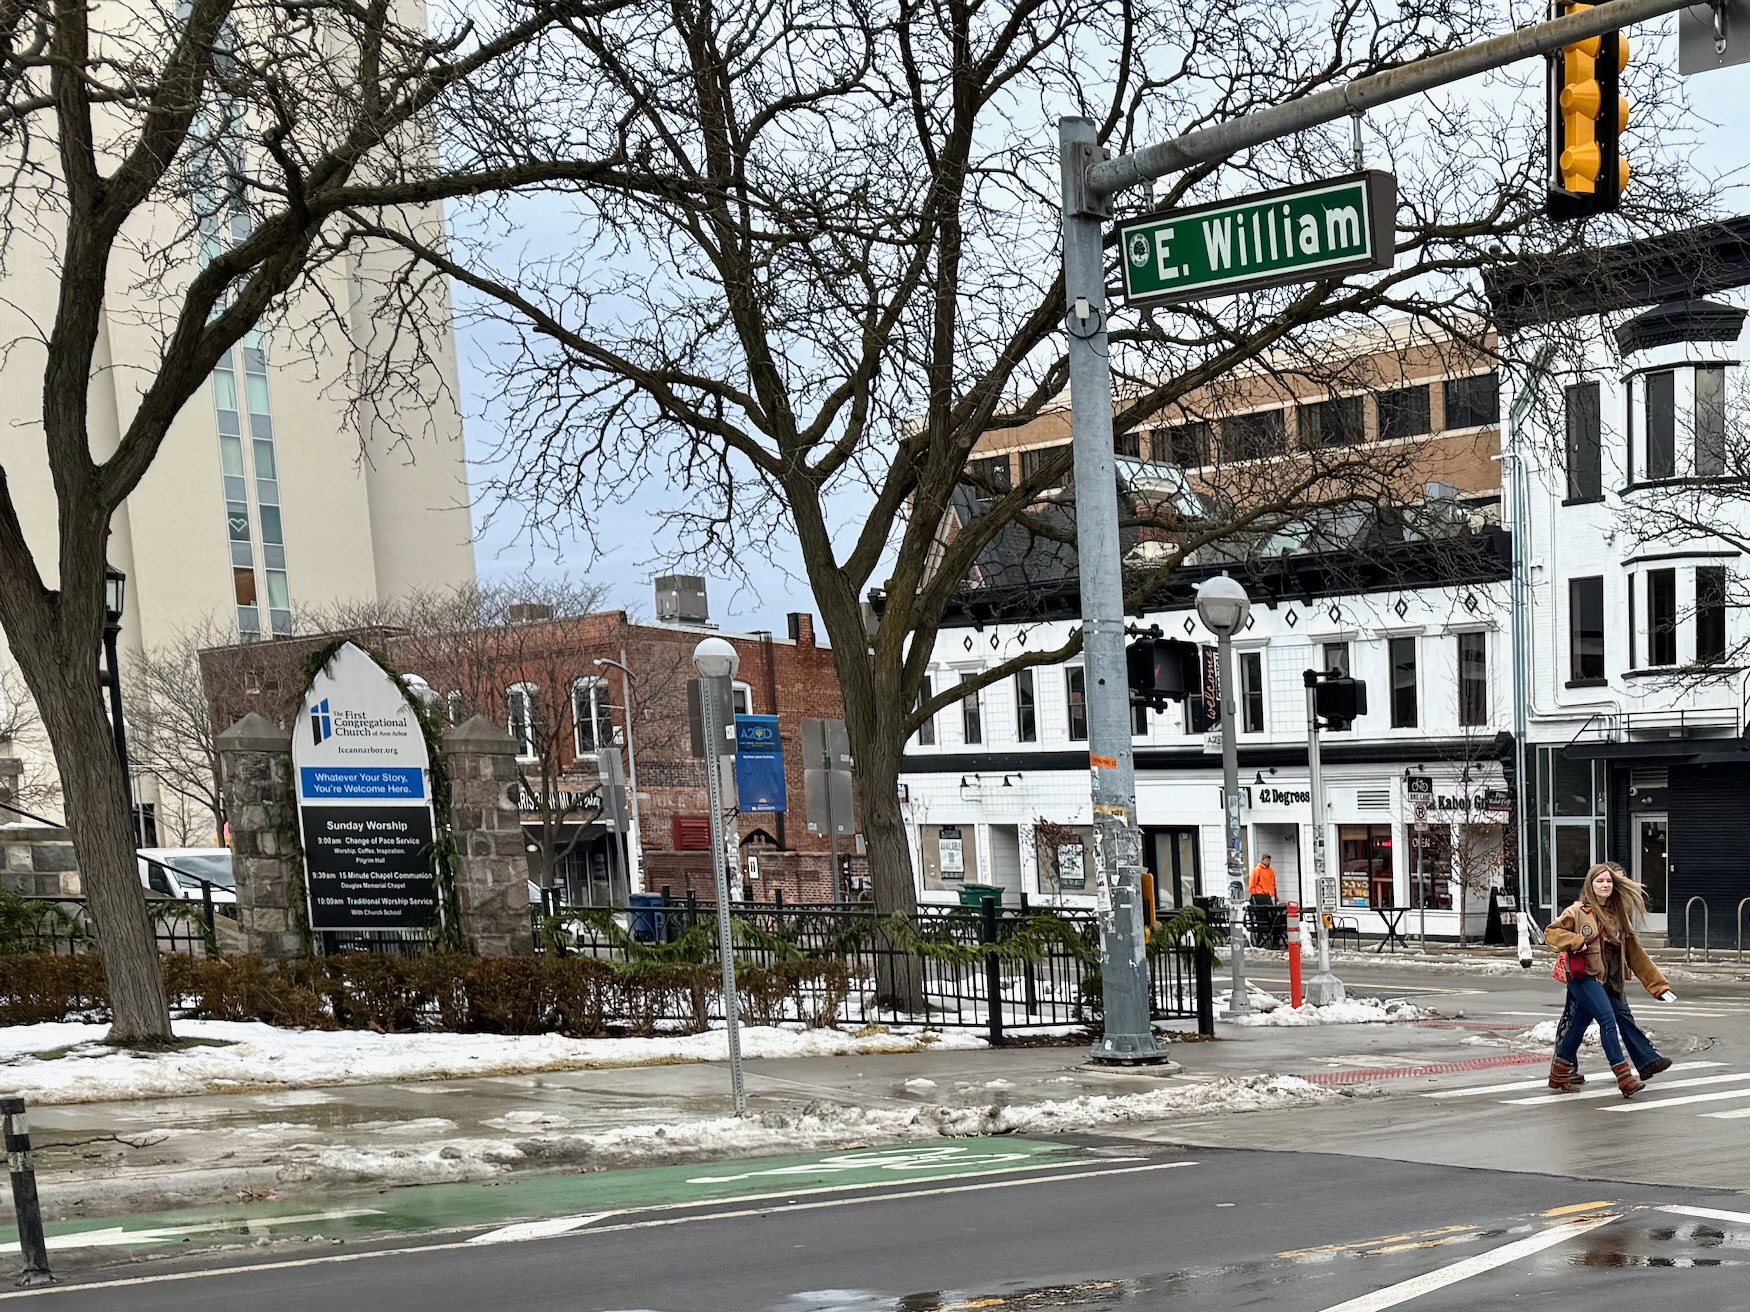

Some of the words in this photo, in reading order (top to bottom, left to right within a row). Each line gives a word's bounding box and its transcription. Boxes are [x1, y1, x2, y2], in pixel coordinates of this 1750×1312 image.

[1154, 228, 1190, 280] E.
[1202, 204, 1361, 271] William
[1204, 649, 1216, 720] welcome
[345, 711, 366, 720] First
[334, 718, 407, 729] Congregational
[335, 728, 371, 736] Church
[338, 746, 398, 754] fccannarbor.org
[315, 773, 357, 782] Whatever
[359, 773, 380, 782] Your
[314, 784, 342, 793] You're
[343, 784, 386, 793] Welcome
[387, 784, 412, 793] Here.
[1260, 789, 1271, 803] 42
[1272, 789, 1311, 806] Degrees
[1410, 793, 1420, 801] BIKE
[327, 821, 364, 832] Sunday
[366, 821, 408, 832] Worship
[345, 837, 370, 846] Change
[378, 837, 395, 845] Pace
[396, 837, 420, 845] Service
[1412, 838, 1430, 848] OEN
[370, 872, 393, 881] Chapel
[341, 882, 362, 890] Douglas
[387, 882, 406, 890] Chapel
[347, 897, 381, 905] Traditional
[381, 897, 408, 906] Worship
[409, 897, 434, 905] Service
